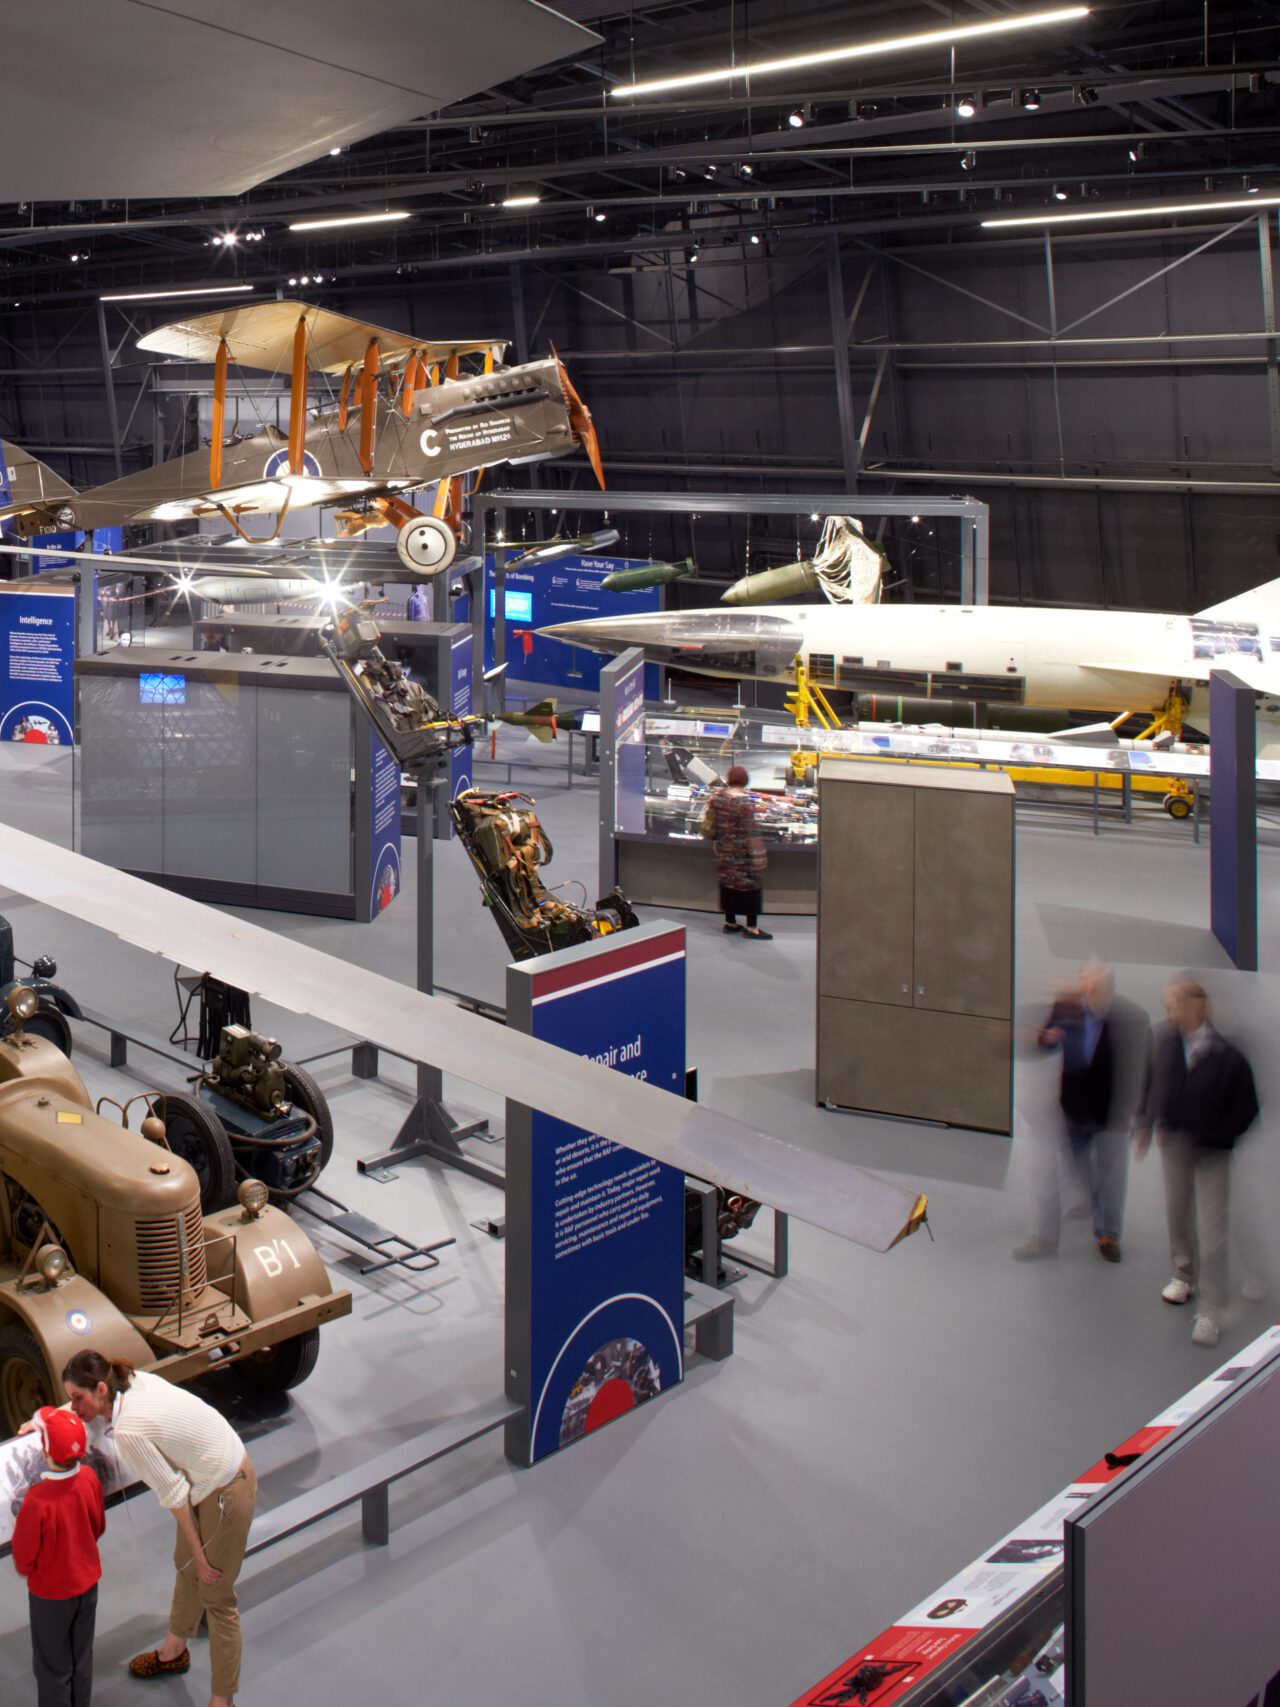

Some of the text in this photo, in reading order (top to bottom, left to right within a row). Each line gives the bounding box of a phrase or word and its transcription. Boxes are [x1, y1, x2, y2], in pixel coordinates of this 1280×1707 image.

[420, 429, 442, 457] C
[449, 439, 491, 451] HYDERABAD
[581, 559, 594, 568] Have
[594, 560, 606, 568] Your
[606, 560, 614, 570] Say
[20, 616, 53, 626] Intelligence
[620, 1034, 641, 1062] and
